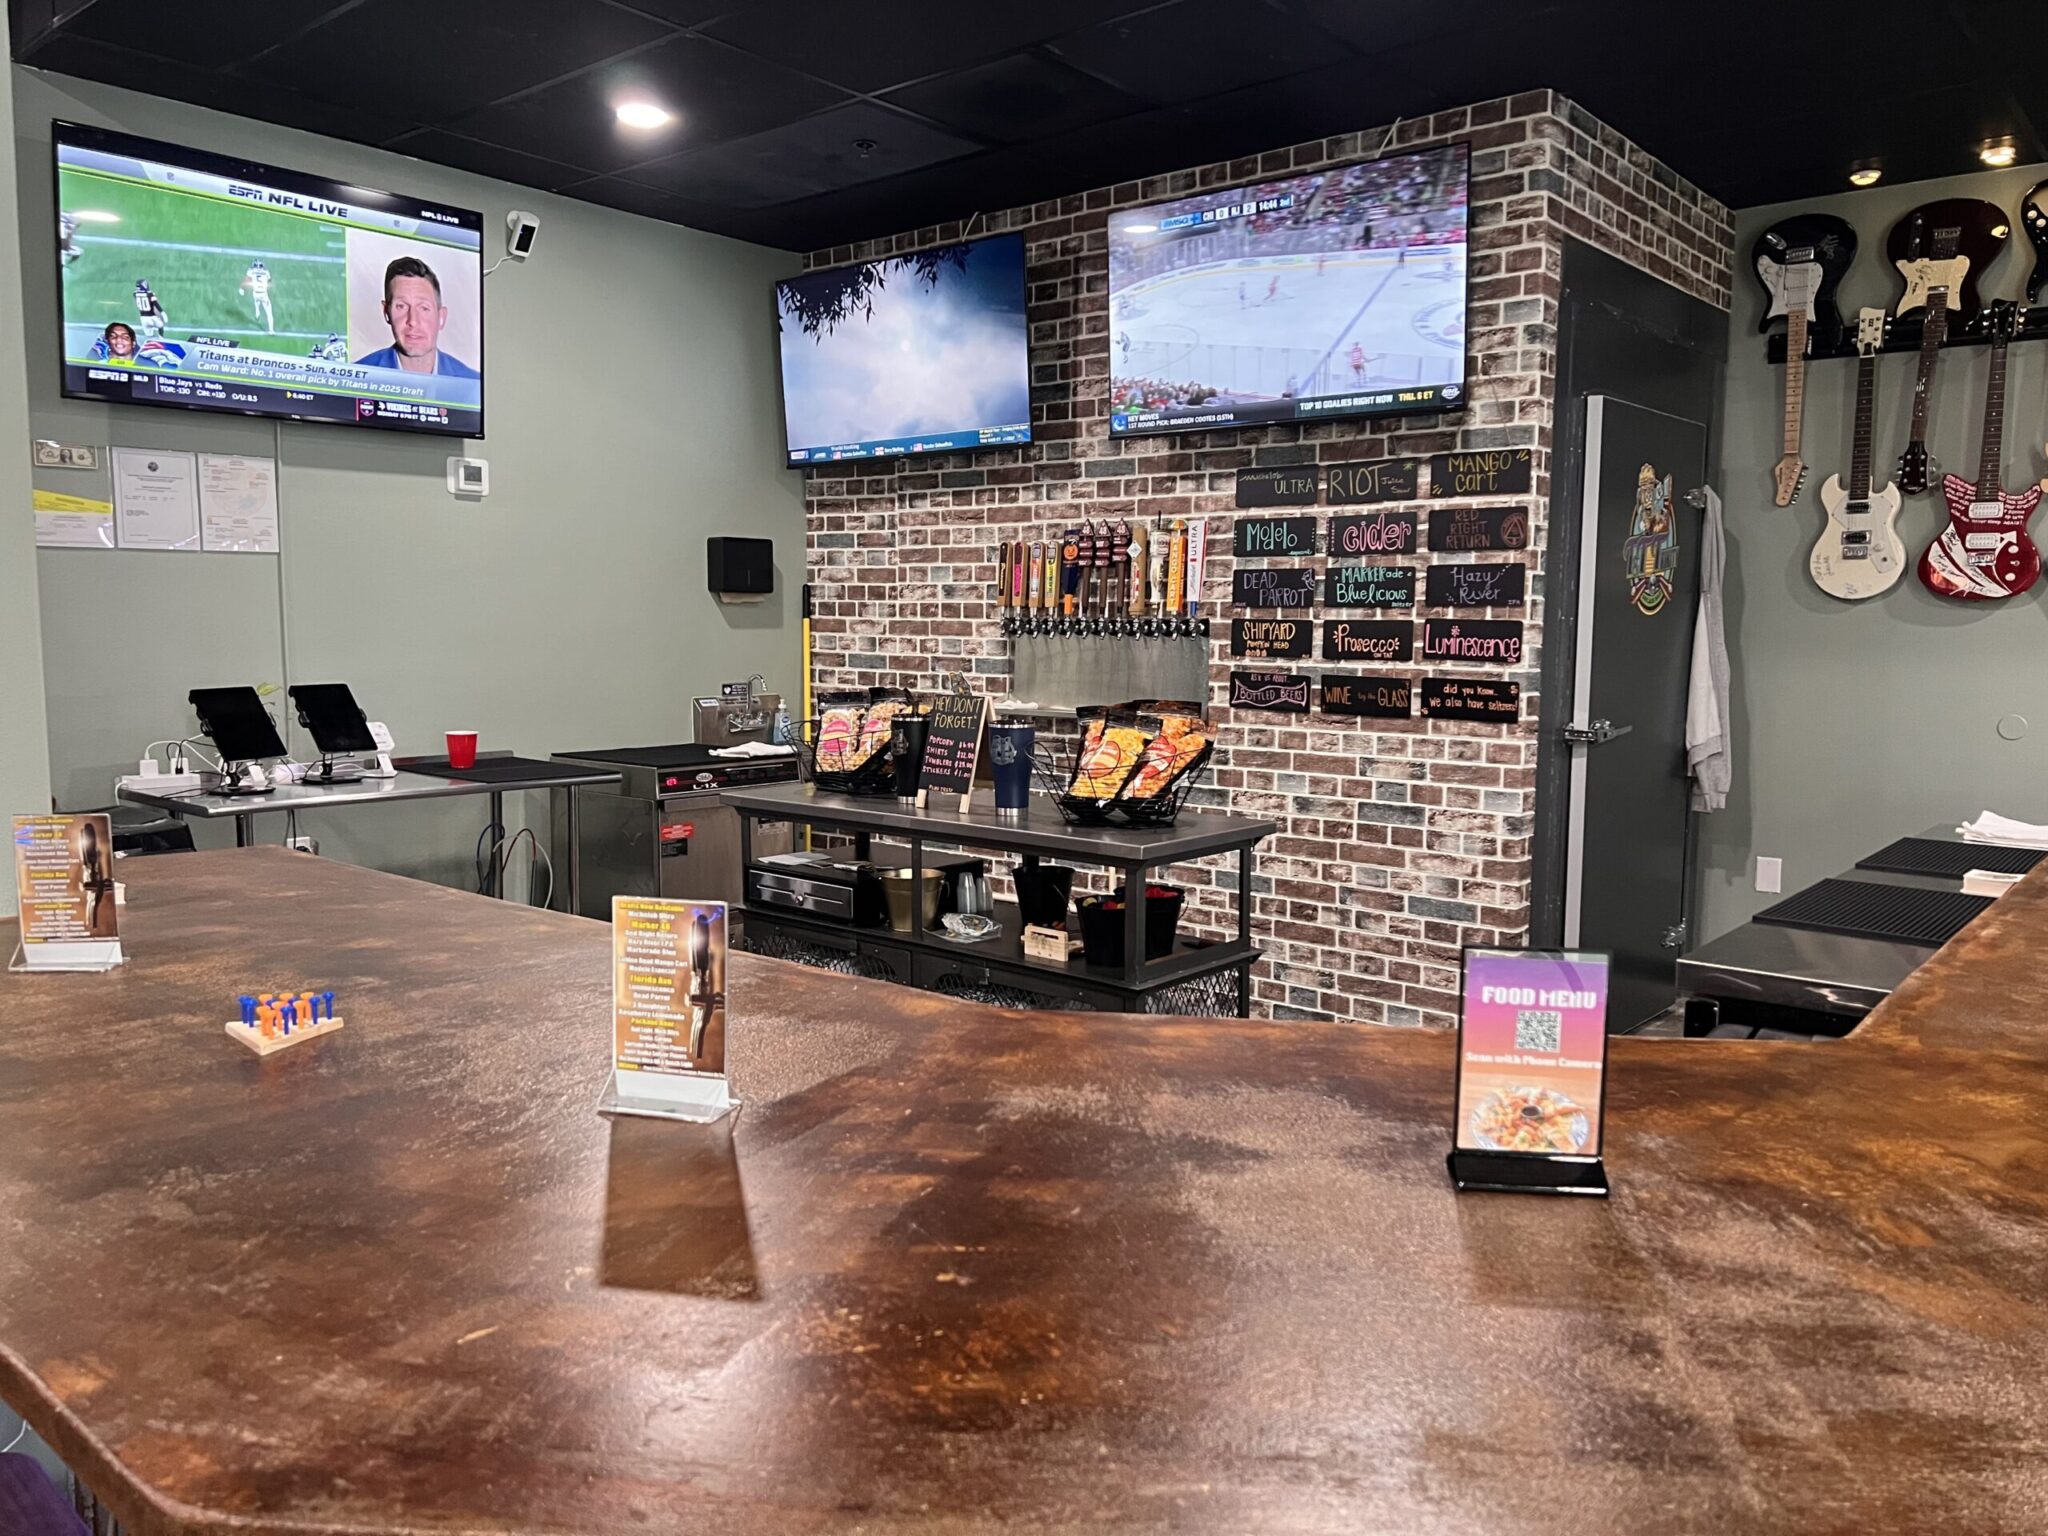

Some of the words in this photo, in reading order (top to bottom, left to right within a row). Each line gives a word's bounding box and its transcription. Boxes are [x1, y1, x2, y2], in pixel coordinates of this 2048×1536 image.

[229, 184, 262, 201] ESPN
[268, 193, 303, 209] NFL
[308, 201, 348, 218] LIVE
[196, 336, 212, 345] NFL
[213, 339, 230, 347] LIVE
[199, 349, 235, 363] Titans
[237, 355, 249, 365] at
[251, 357, 297, 371] Broncos
[305, 364, 327, 375] Sun.
[330, 366, 353, 377] 4:05
[355, 370, 368, 379] ET
[159, 376, 176, 386] Blue
[177, 379, 193, 388] Jays
[197, 361, 219, 371] Cam
[221, 364, 249, 375] Ward:
[251, 368, 266, 377] No.
[275, 371, 306, 381] overall
[308, 374, 326, 384] pick
[328, 377, 340, 386] by
[341, 379, 368, 389] Titans
[369, 382, 378, 391] in
[379, 384, 401, 393] 2025
[402, 386, 424, 396] Draft
[1300, 402, 1313, 410] TOP
[1353, 397, 1375, 406] RIGHT
[1376, 395, 1393, 404] NOW
[1139, 413, 1159, 421] MOVES
[1448, 451, 1512, 472] MANGO
[1274, 478, 1314, 494] ULTRA
[1329, 462, 1392, 498] RIOT
[1455, 509, 1479, 521] RED
[1450, 521, 1488, 534] RIGHT
[1190, 525, 1198, 557] ULTRA
[1246, 521, 1298, 551] Modelo
[1446, 534, 1490, 549] RETURN
[1243, 572, 1277, 589] DEAD
[1450, 566, 1501, 590] Hazy
[1259, 588, 1308, 607] PARROT
[1459, 586, 1501, 605] River
[1242, 621, 1296, 641] SHIPYARD
[1338, 623, 1395, 653] Prosecco
[1273, 642, 1290, 650] HEAD
[1425, 623, 1520, 658] Luminescence
[1251, 674, 1261, 682] ASK
[1240, 690, 1275, 701] BOTTLED
[1280, 688, 1304, 701] BEERS
[1443, 683, 1458, 694] did
[1324, 686, 1352, 705] WINE
[1377, 687, 1409, 708] GLASS
[1467, 698, 1484, 709] have
[929, 735, 954, 746] POPCORN
[926, 746, 948, 756] SHIRTS
[925, 756, 952, 767] TUMBLERS
[1482, 986, 1536, 1006] FOOD
[1539, 989, 1597, 1009] MENU
[1466, 1052, 1492, 1062] Scan
[1494, 1055, 1521, 1065] with
[1523, 1055, 1557, 1066] Phone
